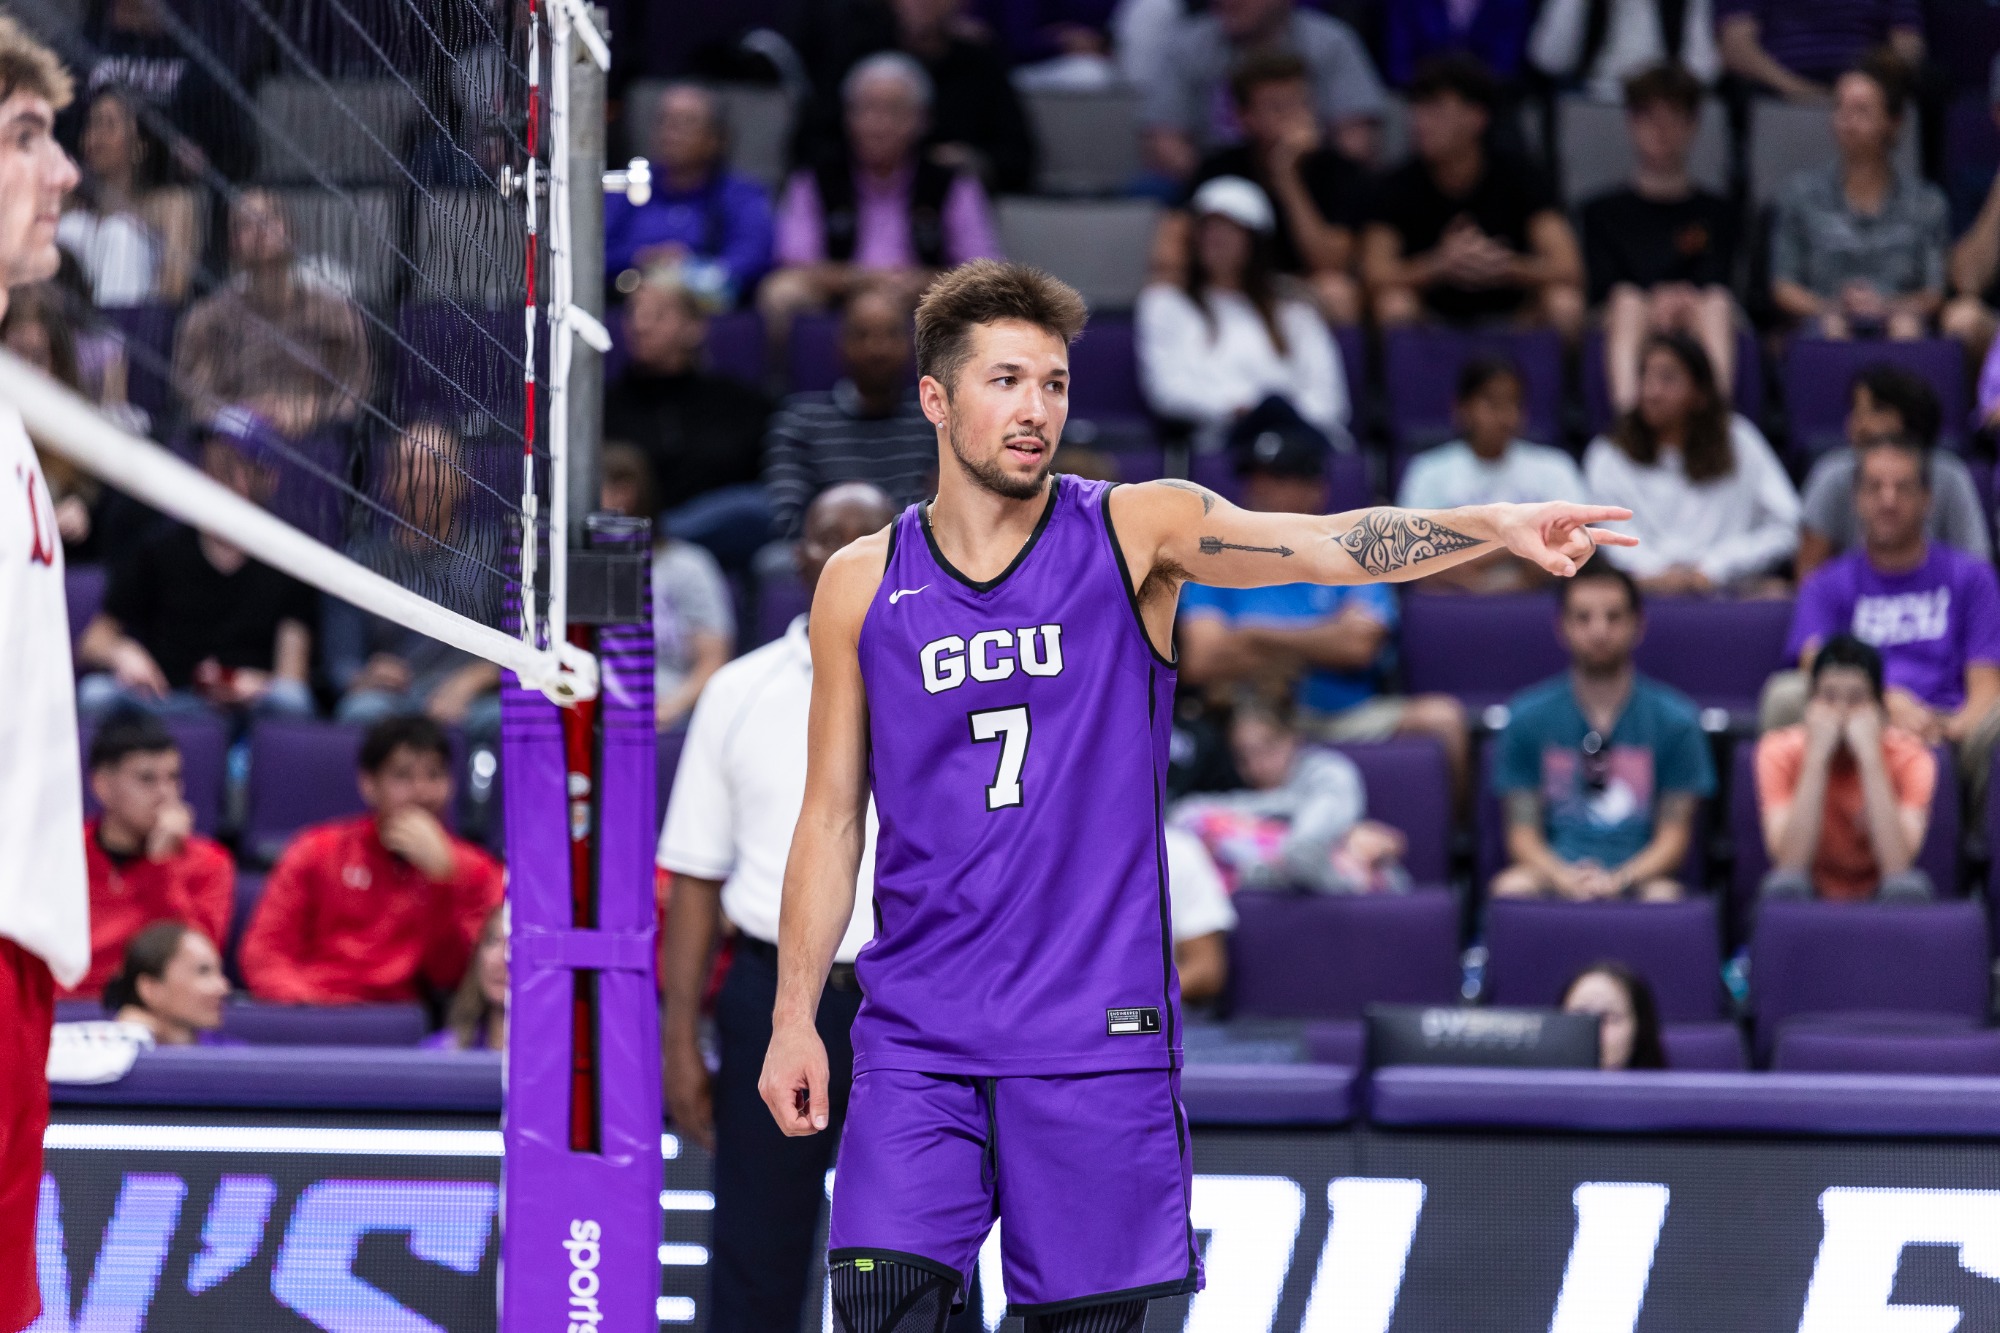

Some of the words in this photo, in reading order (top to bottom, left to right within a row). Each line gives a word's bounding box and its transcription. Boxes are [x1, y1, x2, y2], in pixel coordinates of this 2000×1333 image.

[919, 623, 1065, 696] GCU
[967, 703, 1032, 812] 7
[1146, 1015, 1154, 1026] L
[562, 1219, 604, 1333] sports
